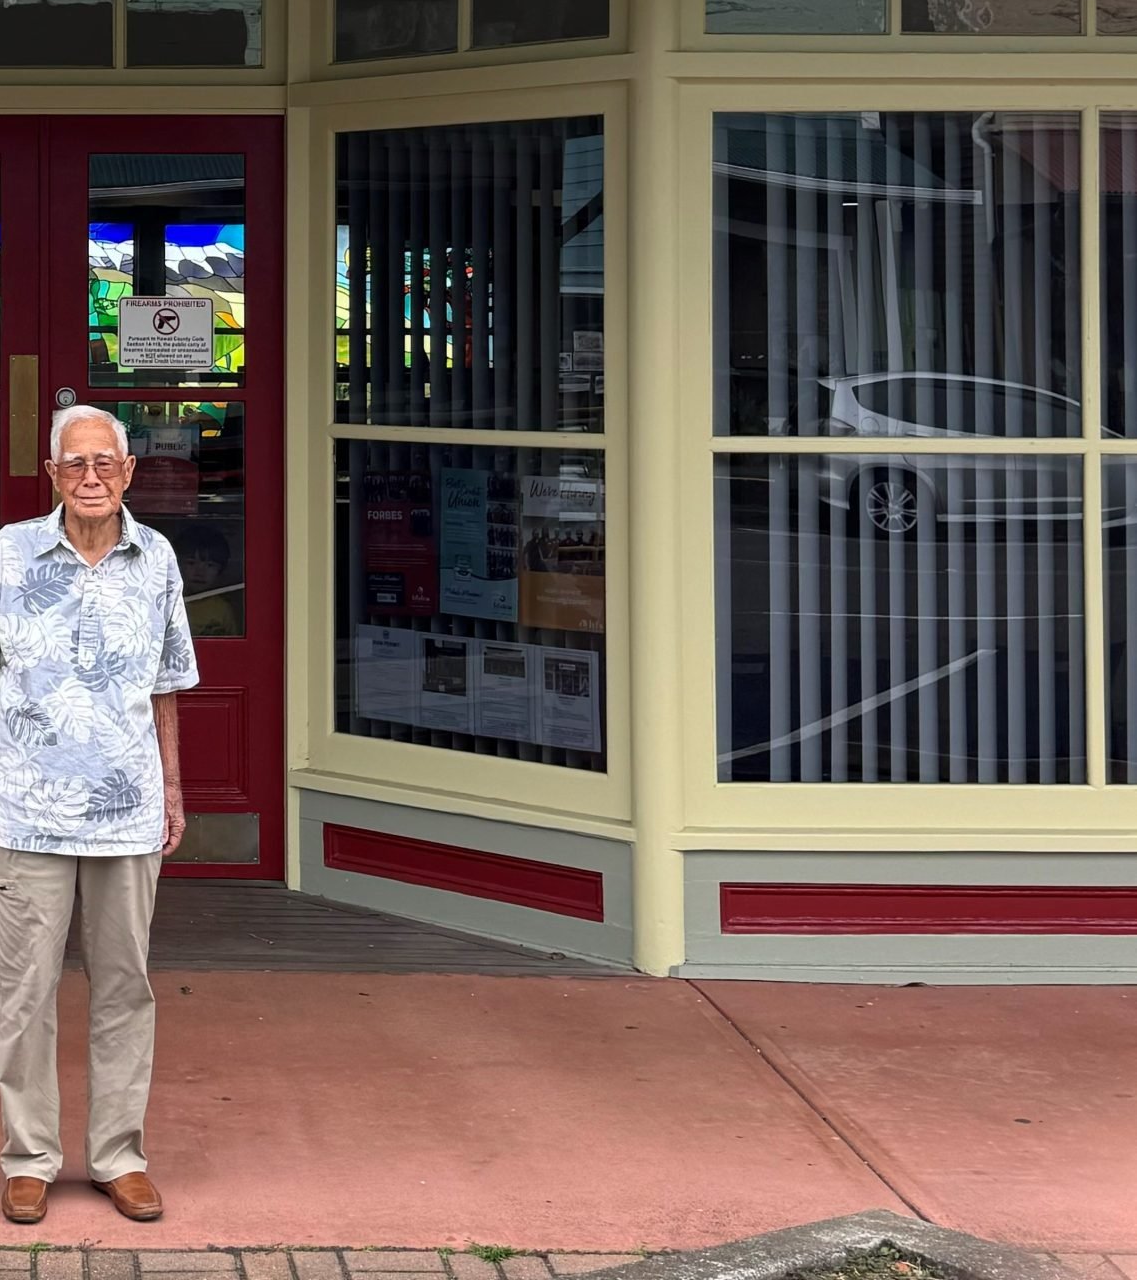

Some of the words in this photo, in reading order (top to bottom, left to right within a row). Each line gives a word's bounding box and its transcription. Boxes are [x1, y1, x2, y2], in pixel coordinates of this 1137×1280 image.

[125, 300, 162, 308] FIREARMS
[163, 300, 207, 308] PROHIBITED
[154, 442, 187, 451] PUBLIC
[367, 510, 404, 520] FORBES
